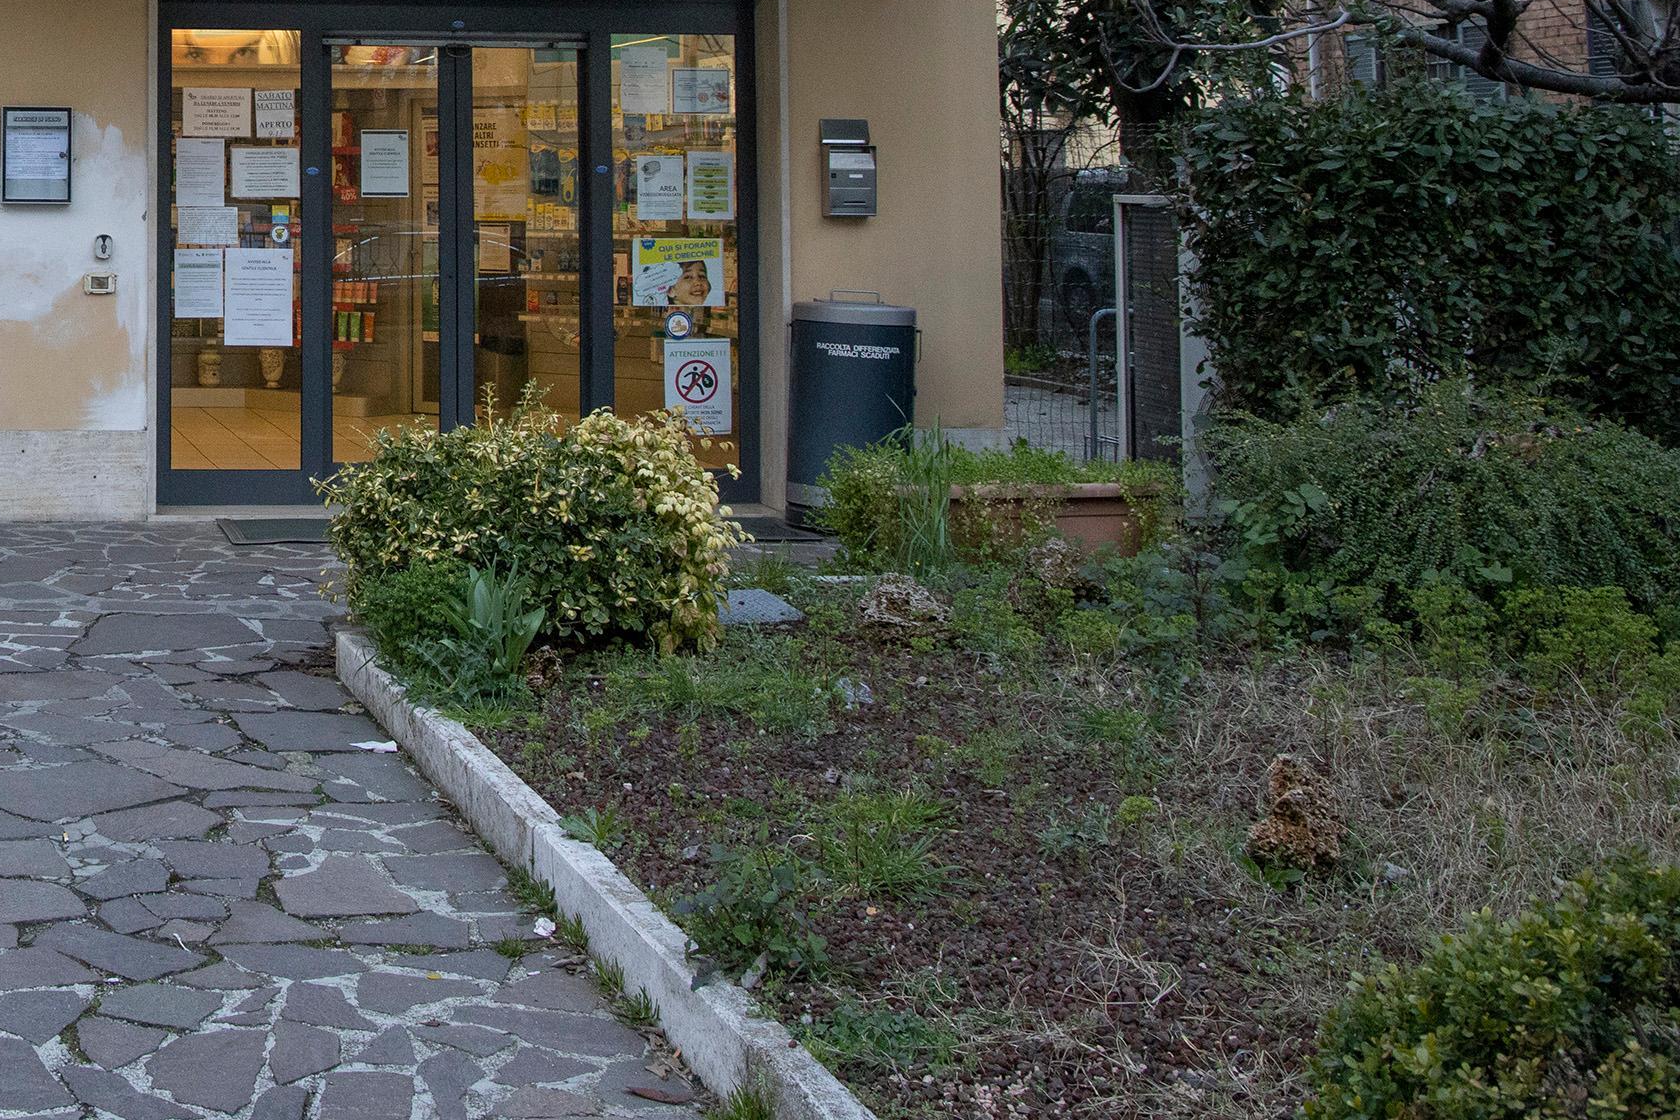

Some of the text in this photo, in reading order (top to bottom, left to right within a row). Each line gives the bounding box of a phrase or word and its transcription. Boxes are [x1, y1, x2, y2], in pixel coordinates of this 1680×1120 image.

[257, 92, 292, 100] SABATO
[256, 102, 294, 110] MATTINA
[260, 120, 292, 129] APERTO
[473, 122, 497, 130] NZARE
[684, 240, 718, 250] FORANO
[816, 342, 900, 354] RACCOLTA DIFFERENZIATA
[828, 349, 890, 360] FARMACI SCADUTI
